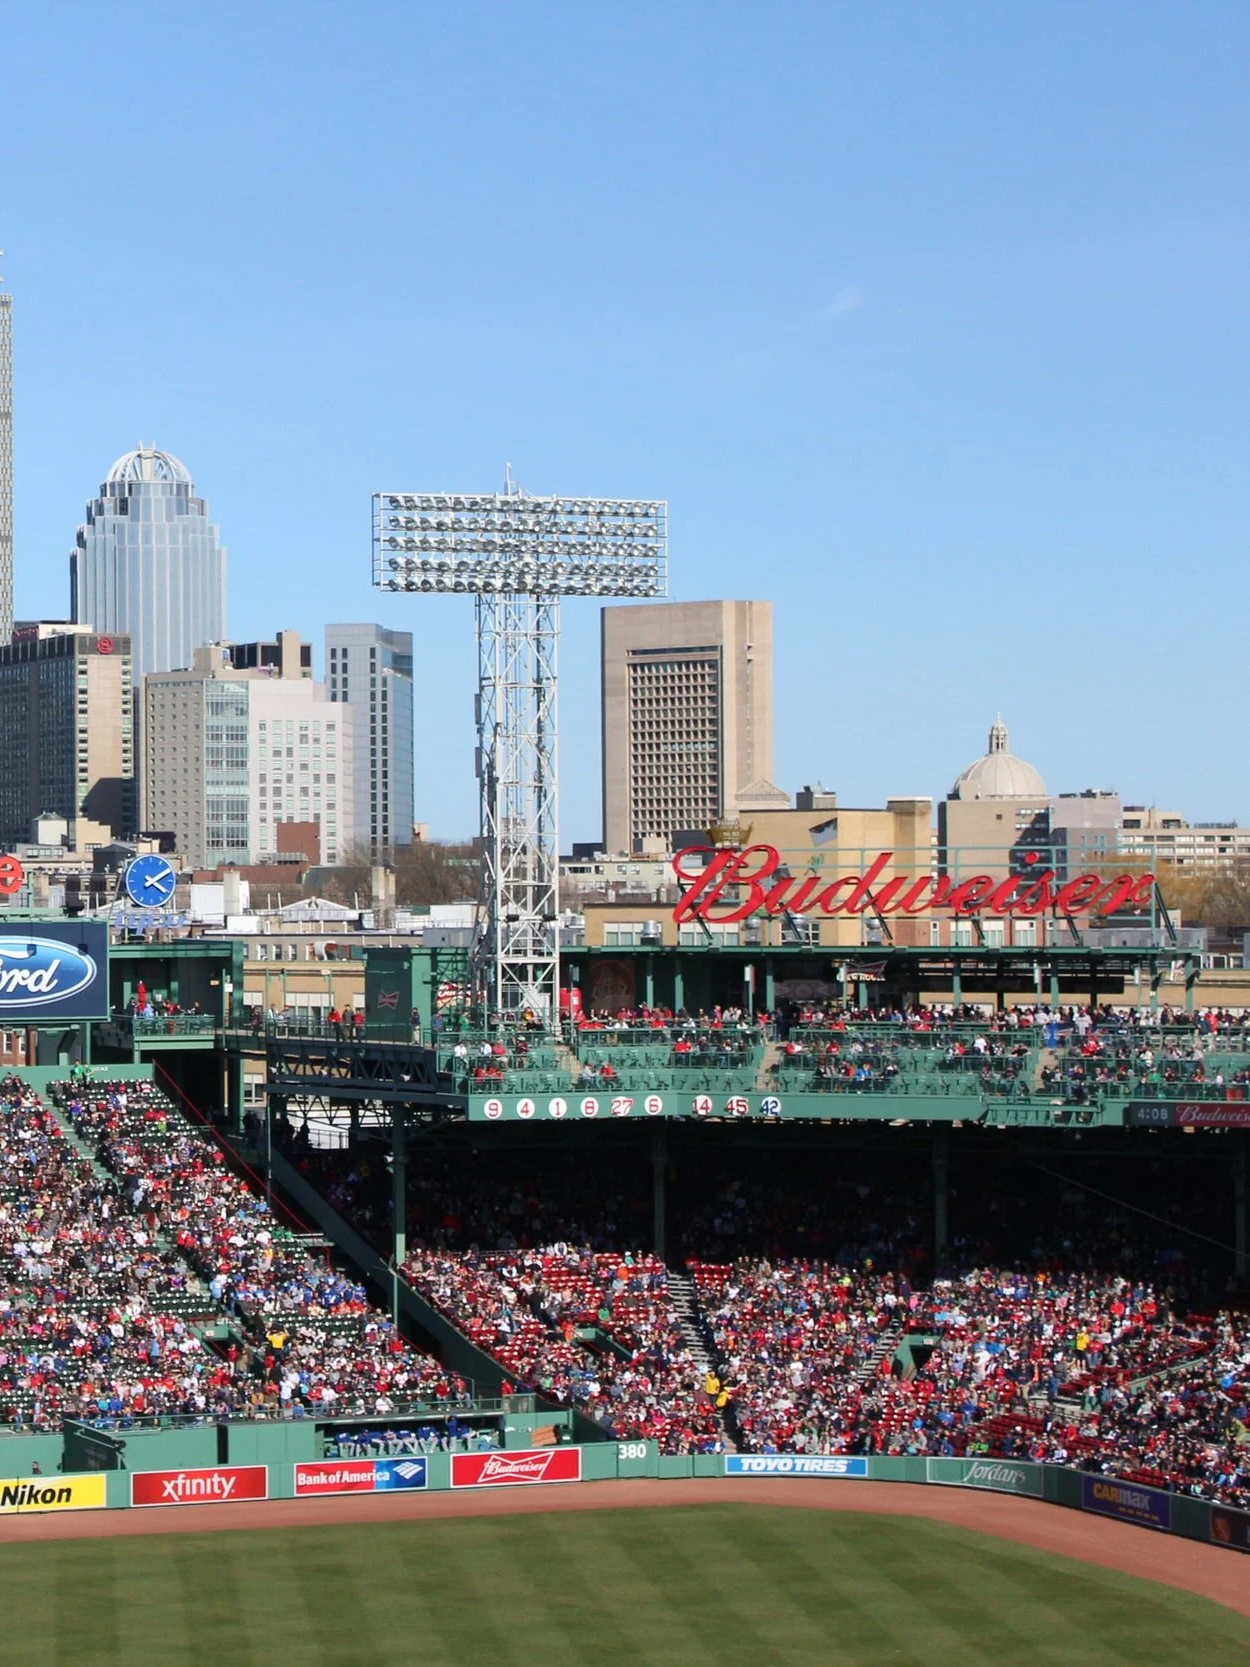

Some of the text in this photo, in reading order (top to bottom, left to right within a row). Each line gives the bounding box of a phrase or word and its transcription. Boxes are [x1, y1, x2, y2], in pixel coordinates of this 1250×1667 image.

[672, 844, 1155, 925] Budweiser
[488, 1098, 780, 1116] 9 4 1 8 27 6 14 45 42
[618, 1444, 646, 1460] 380
[486, 1462, 547, 1476] Budweiser
[740, 1457, 848, 1472] TOYO TIRES
[963, 1461, 1026, 1484] Jordan's
[162, 1473, 237, 1501] xfinity
[298, 1470, 390, 1486] Bank of America
[0, 1485, 72, 1507] Nikon
